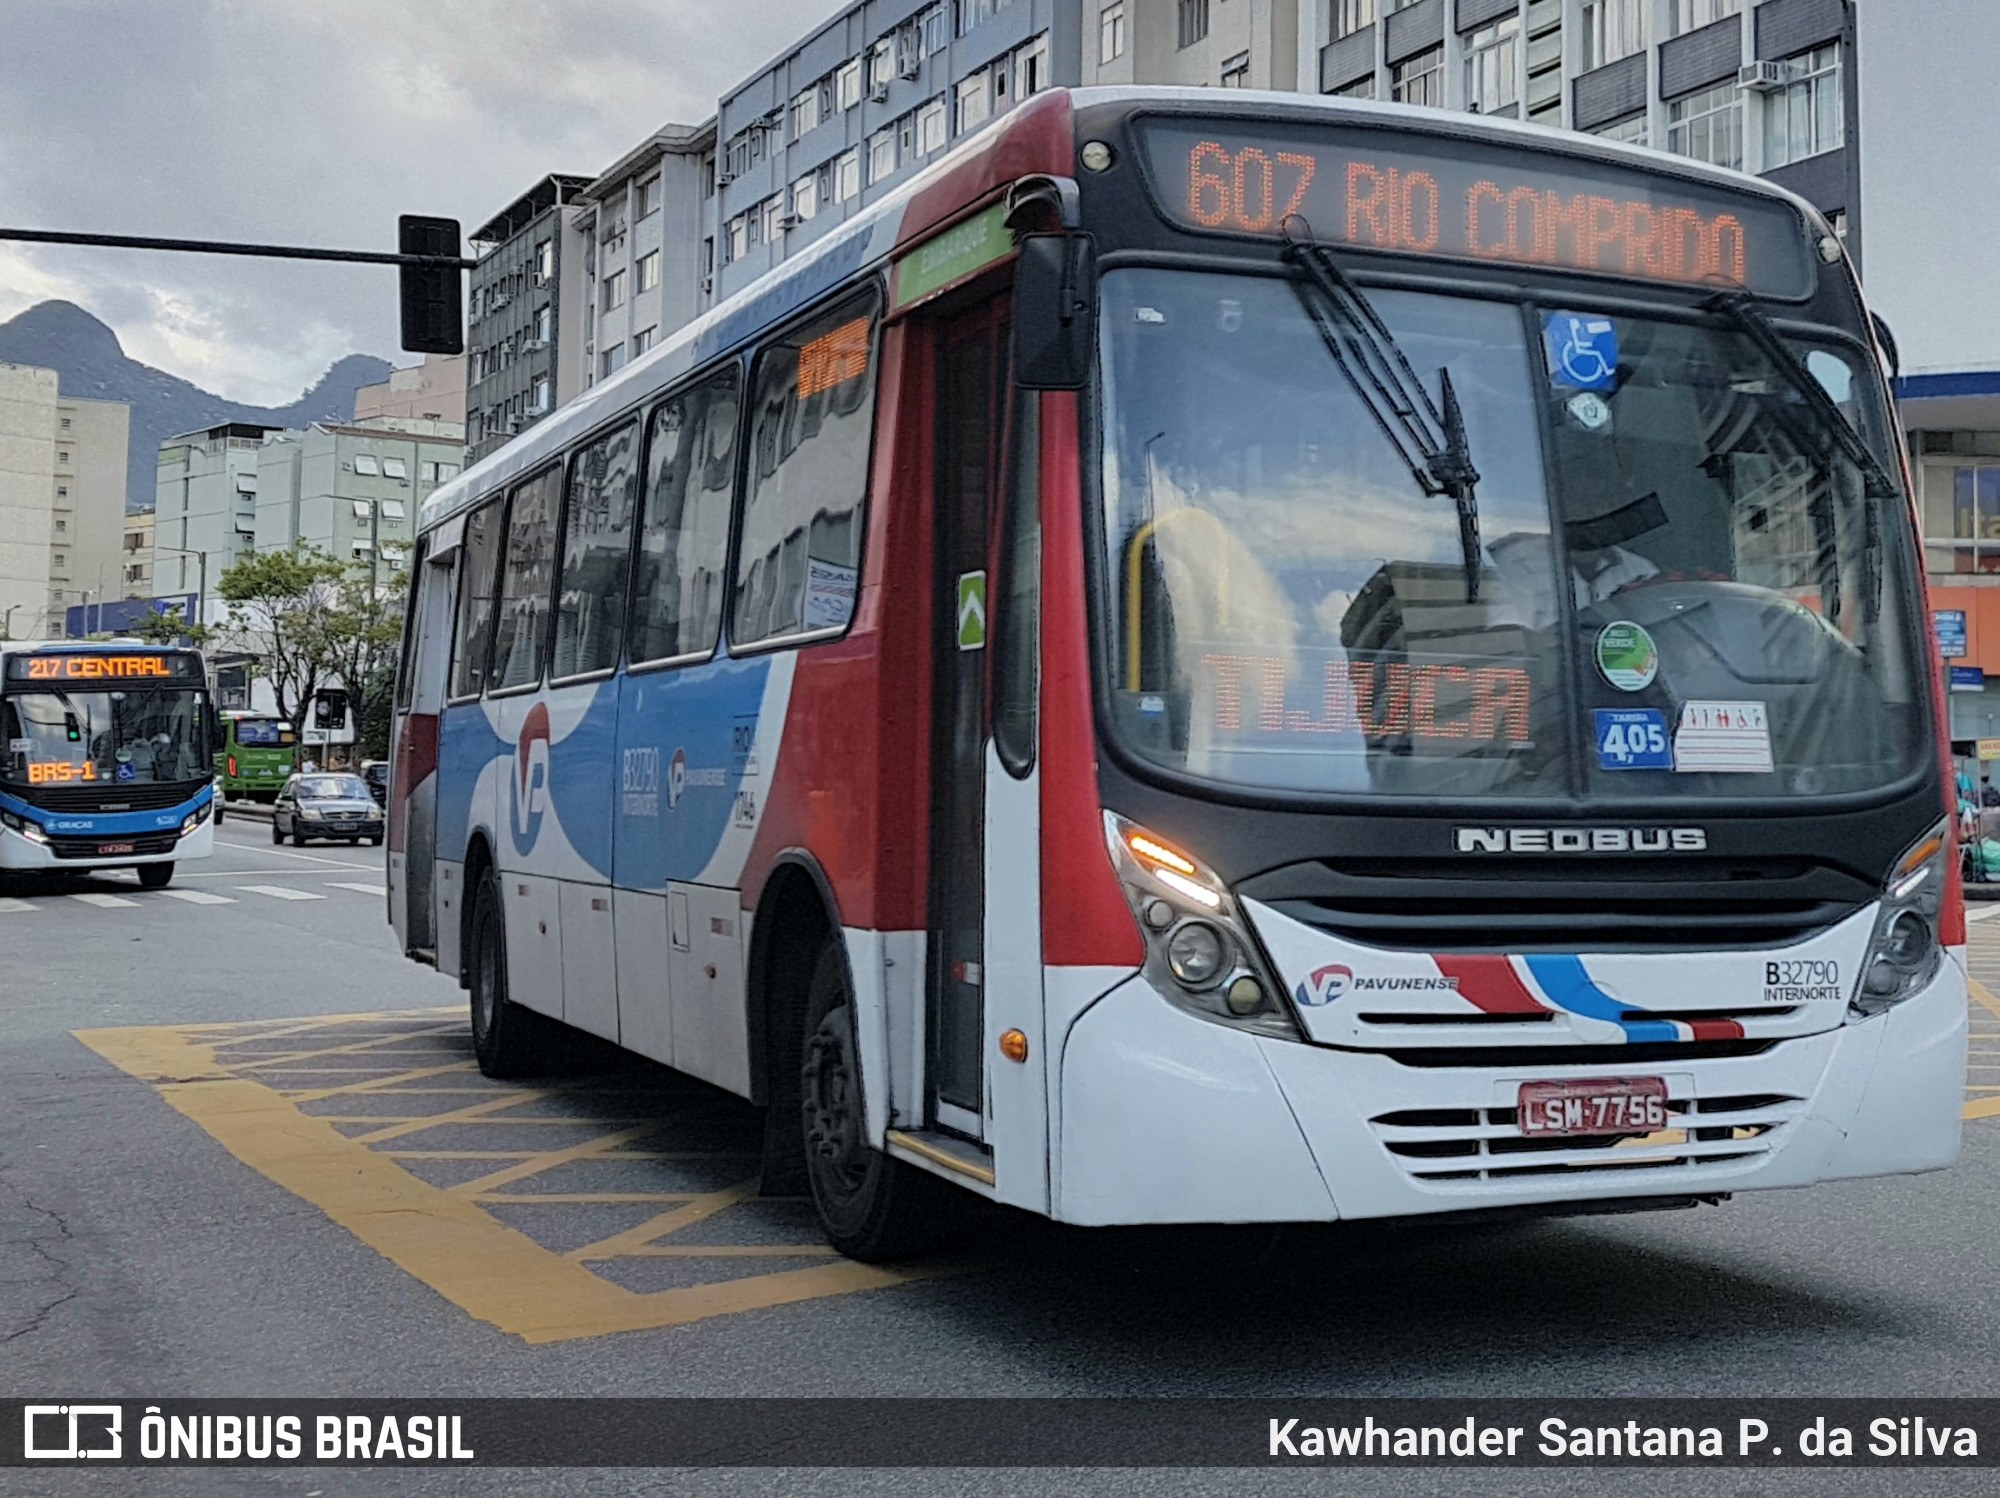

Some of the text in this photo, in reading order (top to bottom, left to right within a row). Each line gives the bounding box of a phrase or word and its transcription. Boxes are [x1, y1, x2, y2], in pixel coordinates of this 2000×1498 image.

[1187, 139, 1745, 283] 607 RIO COMPRIDO
[29, 657, 171, 678] 217 CENTRAL
[1202, 653, 1531, 741] TIJUCA
[28, 761, 95, 783] BRS-1
[1456, 827, 1706, 853] NEOBUS
[1354, 976, 1459, 991] PAVUNENSE
[1766, 960, 1839, 985] B32790
[1764, 986, 1842, 1001] INTERNORTE
[1525, 1095, 1664, 1130] LSM-7756
